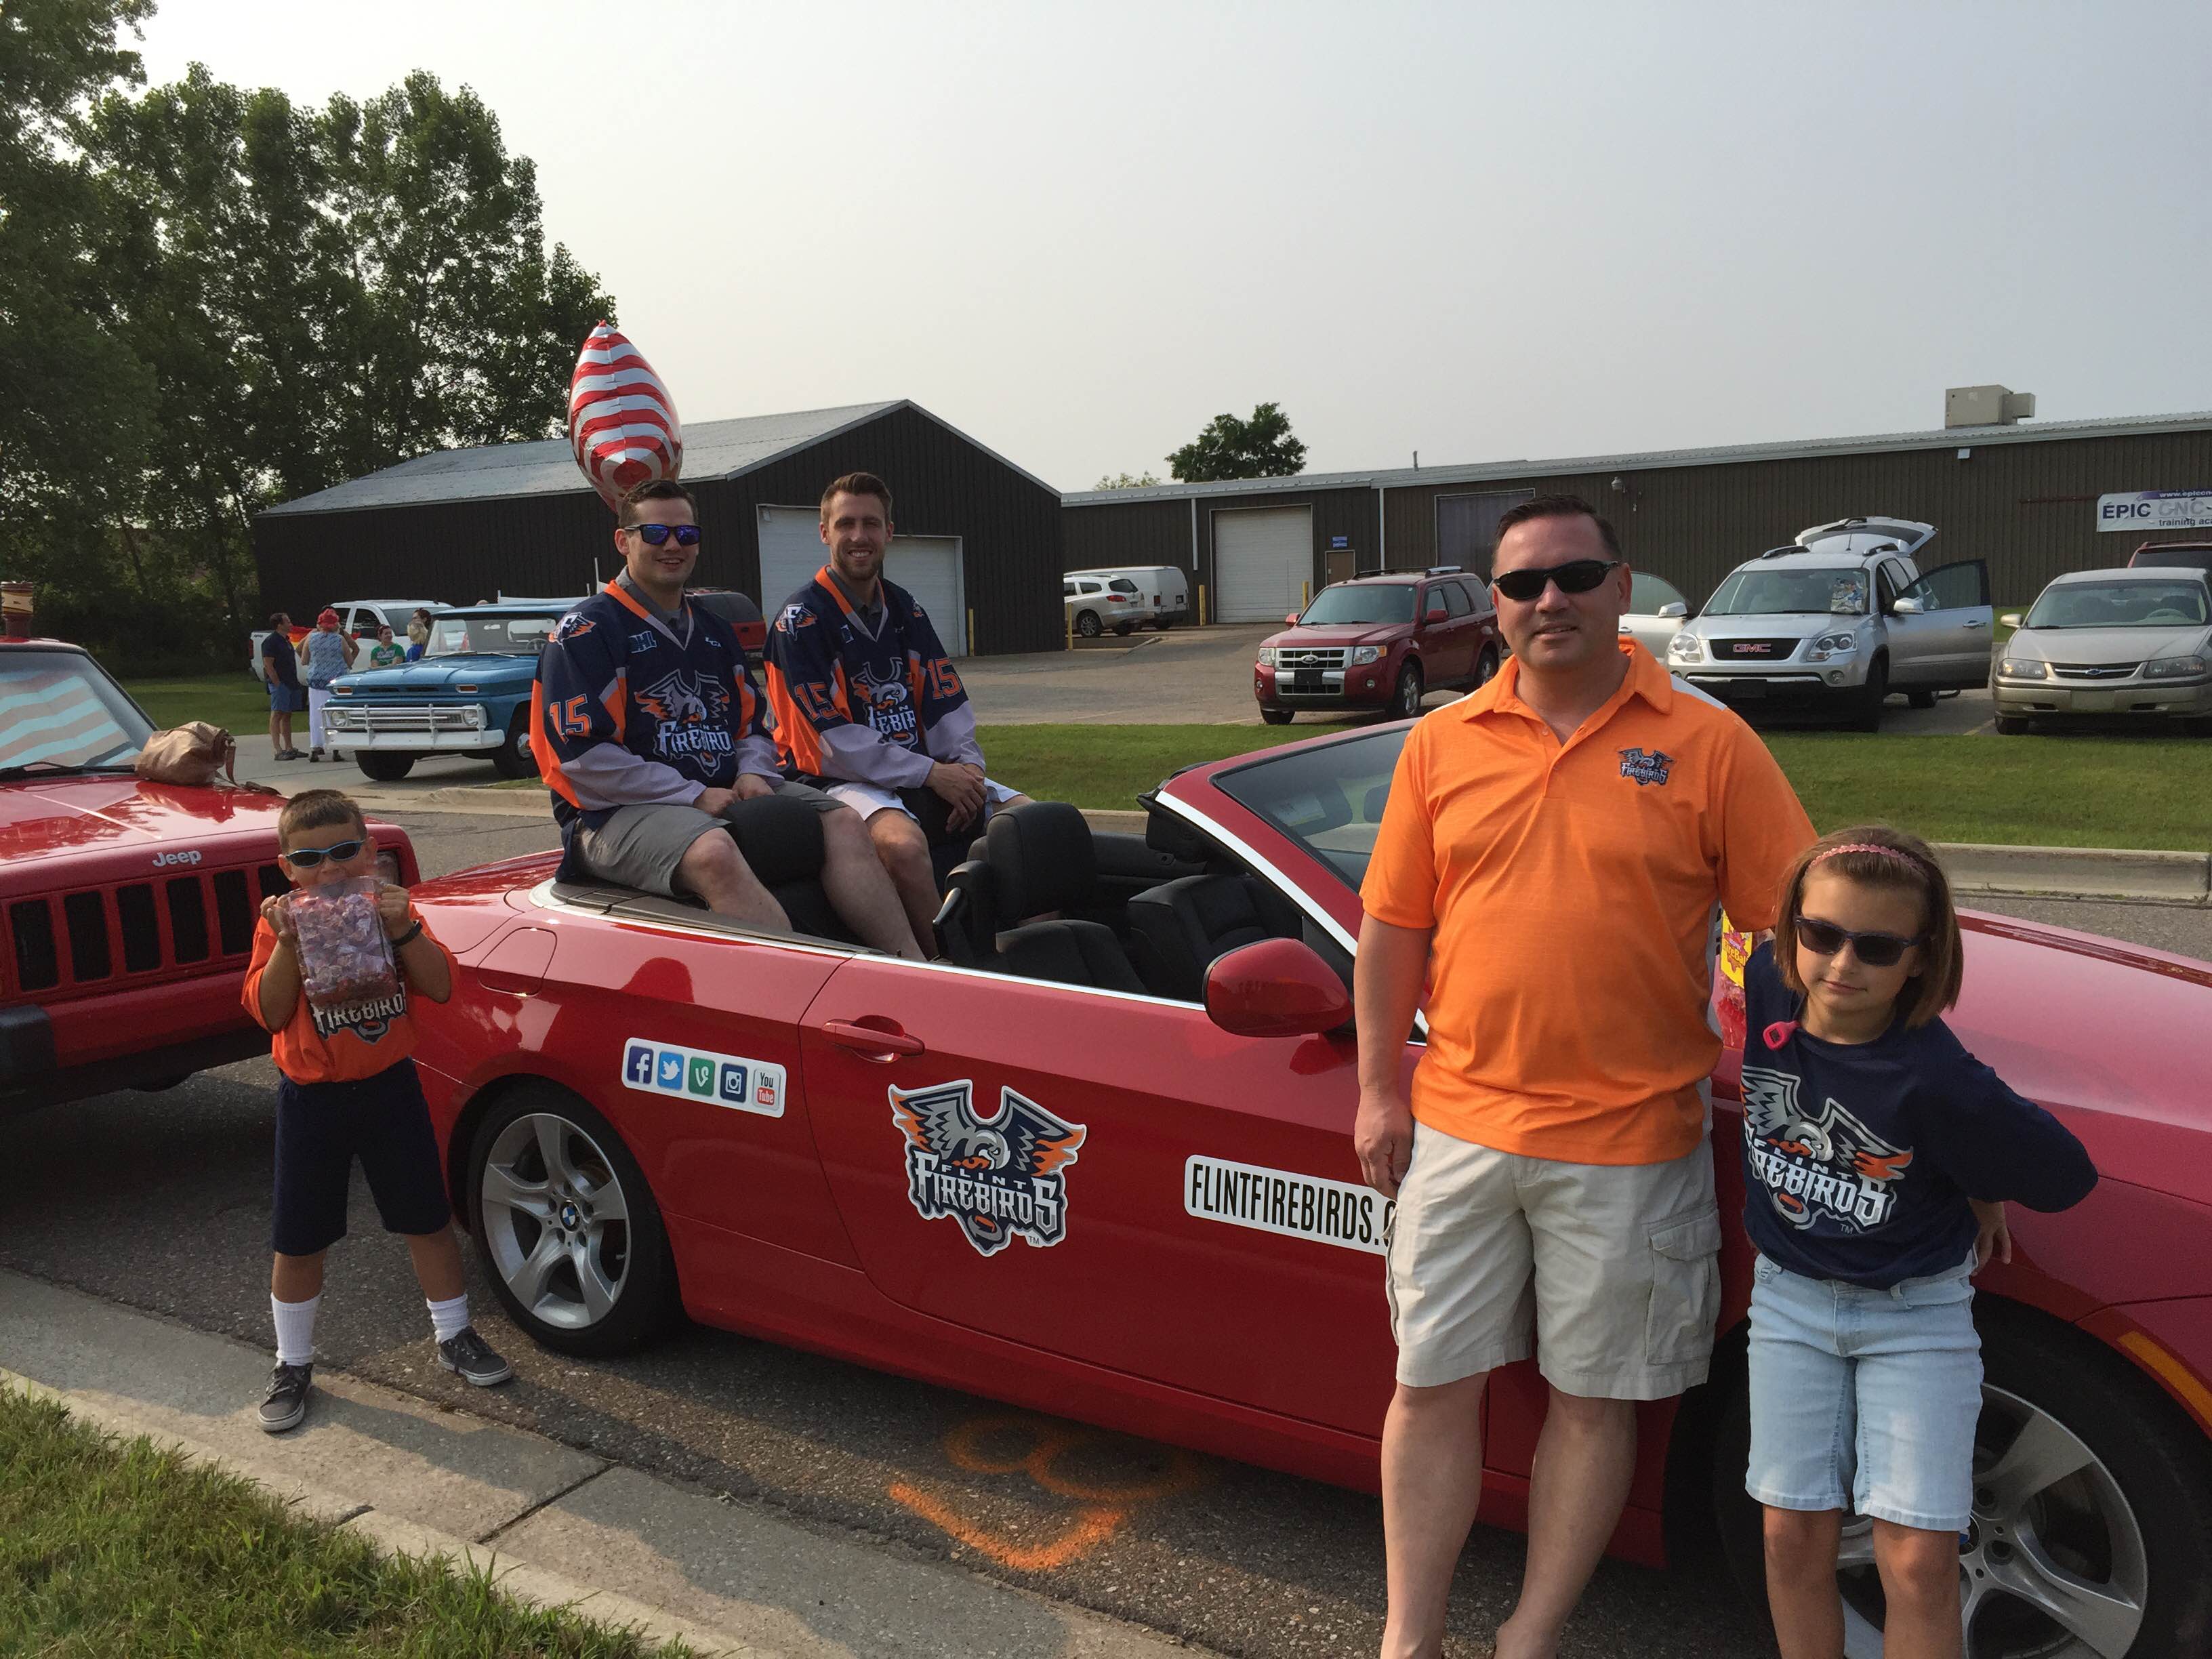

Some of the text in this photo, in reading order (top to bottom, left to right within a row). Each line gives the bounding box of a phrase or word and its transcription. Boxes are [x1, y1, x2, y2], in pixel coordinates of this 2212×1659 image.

[2103, 503, 2151, 519] EPIC
[2158, 518, 2196, 527] training
[1732, 644, 1771, 653] GMC
[926, 657, 962, 699] 15
[794, 682, 840, 722] 15
[549, 693, 592, 745] 15
[152, 851, 202, 867] Jeep
[310, 989, 406, 1035] FIREBIRD
[760, 1072, 774, 1088] You
[758, 1089, 774, 1103] Tube
[1754, 1139, 1853, 1180] FLINT
[942, 1165, 1027, 1190] FLINT
[914, 1150, 1059, 1235] FIREBIRDS
[1840, 1223, 1853, 1234] TM
[1029, 1235, 1040, 1245] TM
